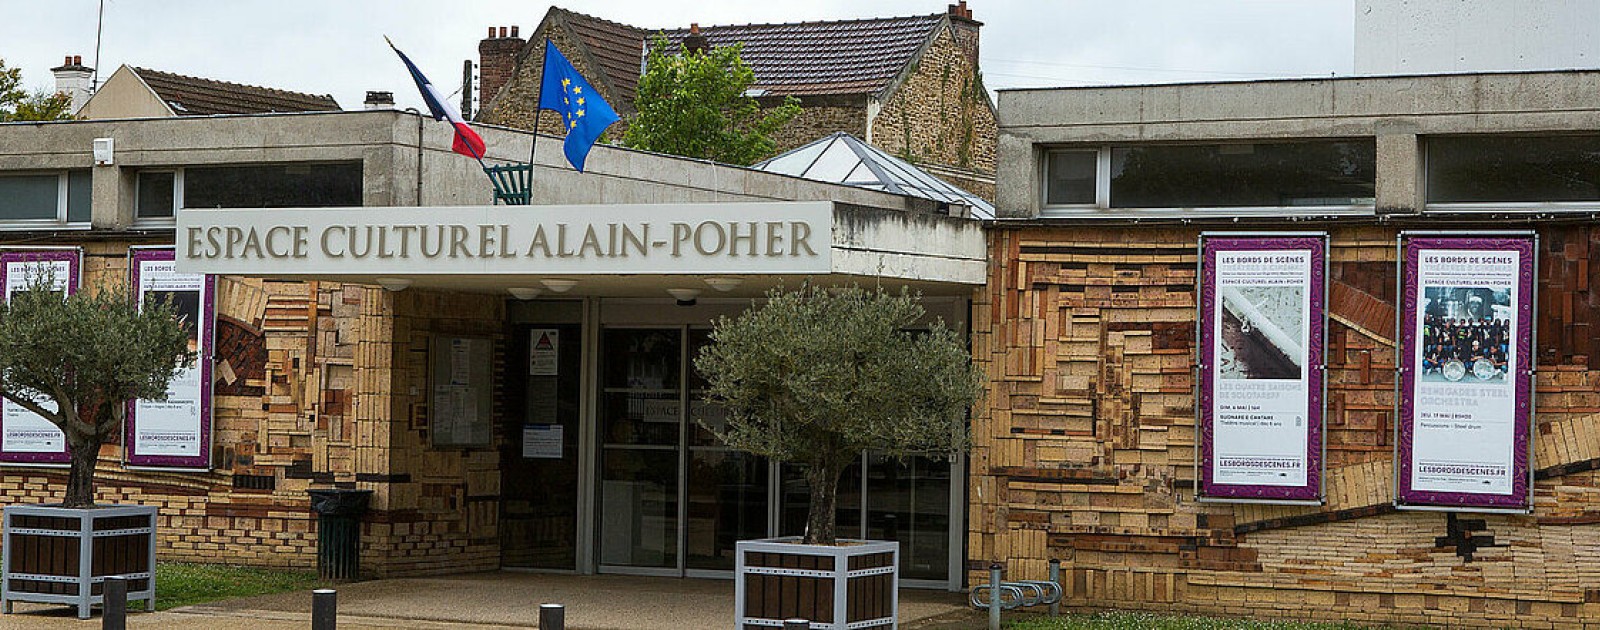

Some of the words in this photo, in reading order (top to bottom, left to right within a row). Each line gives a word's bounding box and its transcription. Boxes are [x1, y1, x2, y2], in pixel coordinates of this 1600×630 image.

[186, 225, 308, 259] ESPACE
[320, 224, 516, 258] CULTUREL
[526, 220, 818, 257] ALAIN-POHER
[1419, 466, 1505, 476] LESBORDSDESCENES.FR
